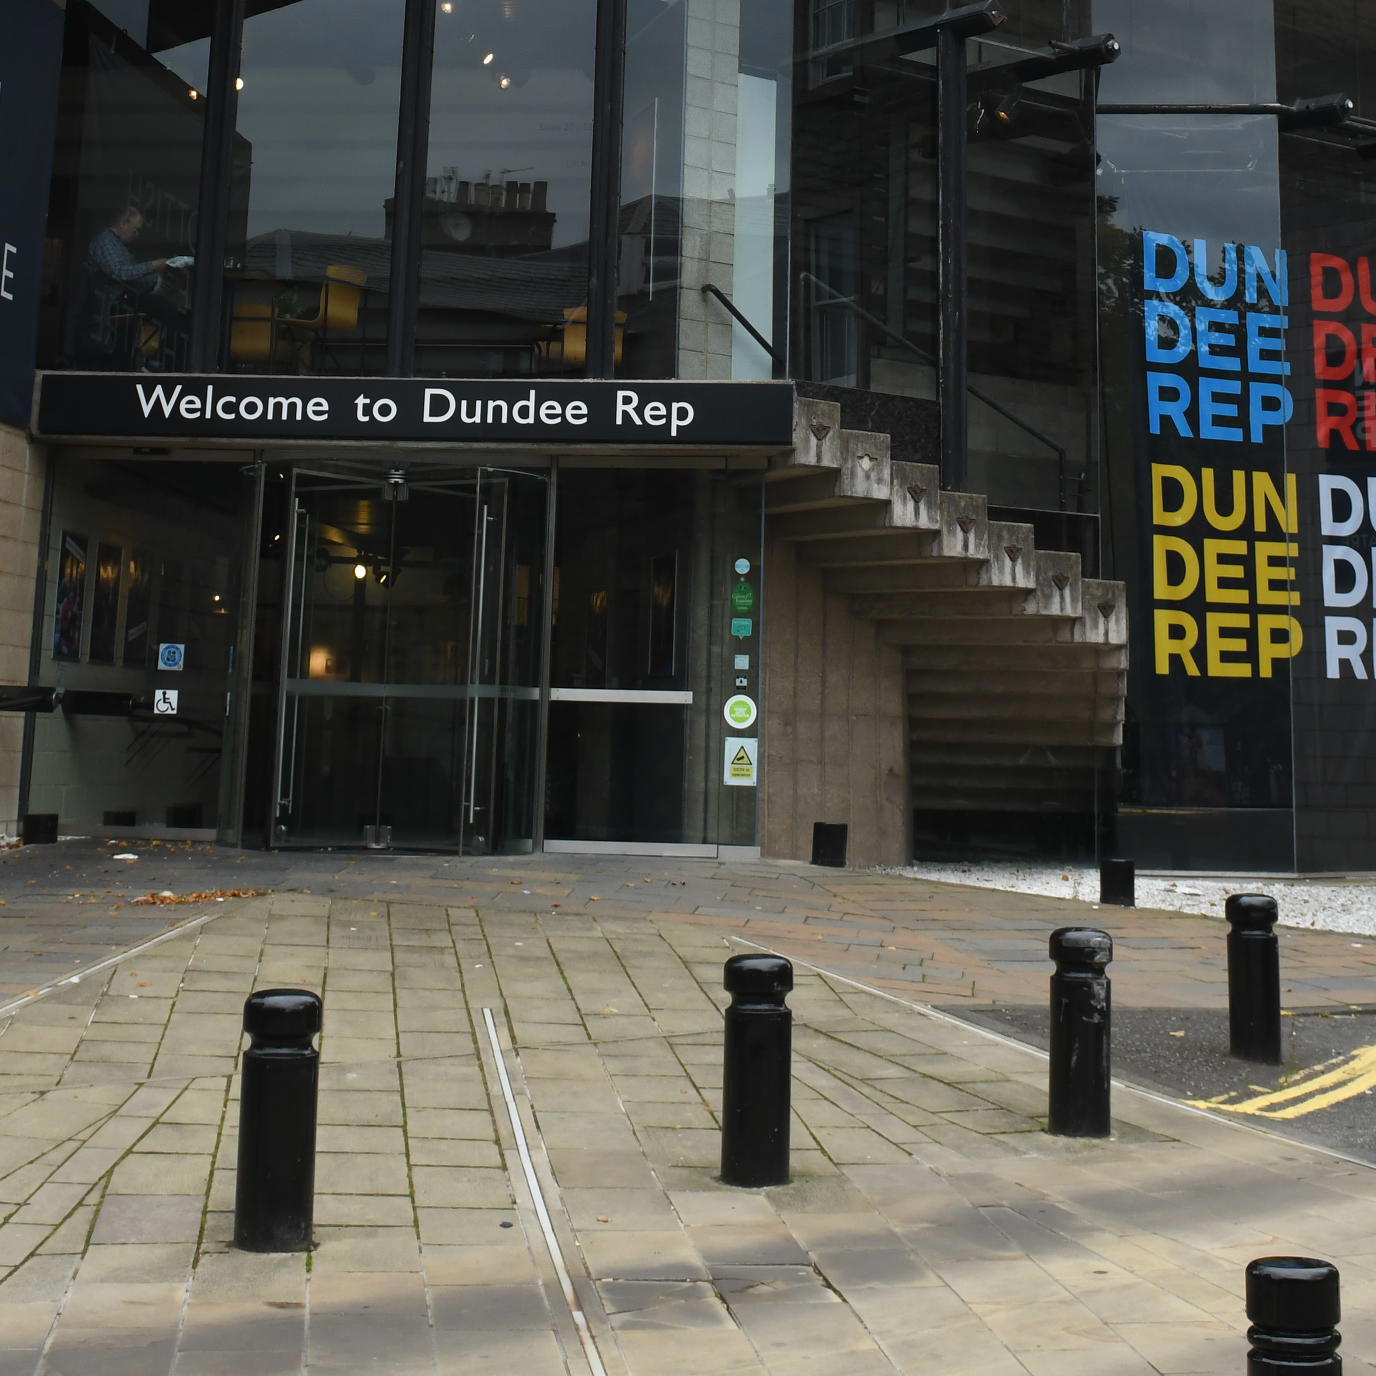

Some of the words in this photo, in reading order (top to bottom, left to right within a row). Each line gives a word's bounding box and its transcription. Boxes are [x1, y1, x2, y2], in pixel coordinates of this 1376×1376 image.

[1142, 230, 1289, 307] DUN
[1144, 300, 1291, 376] DEE
[135, 383, 329, 422] Welcome
[354, 392, 398, 424] to
[422, 387, 589, 425] Dundee
[614, 391, 695, 436] Rep
[1147, 371, 1294, 444] REP
[1151, 462, 1299, 534] DUN
[1152, 534, 1301, 606] DEE
[1153, 608, 1304, 678] REP
